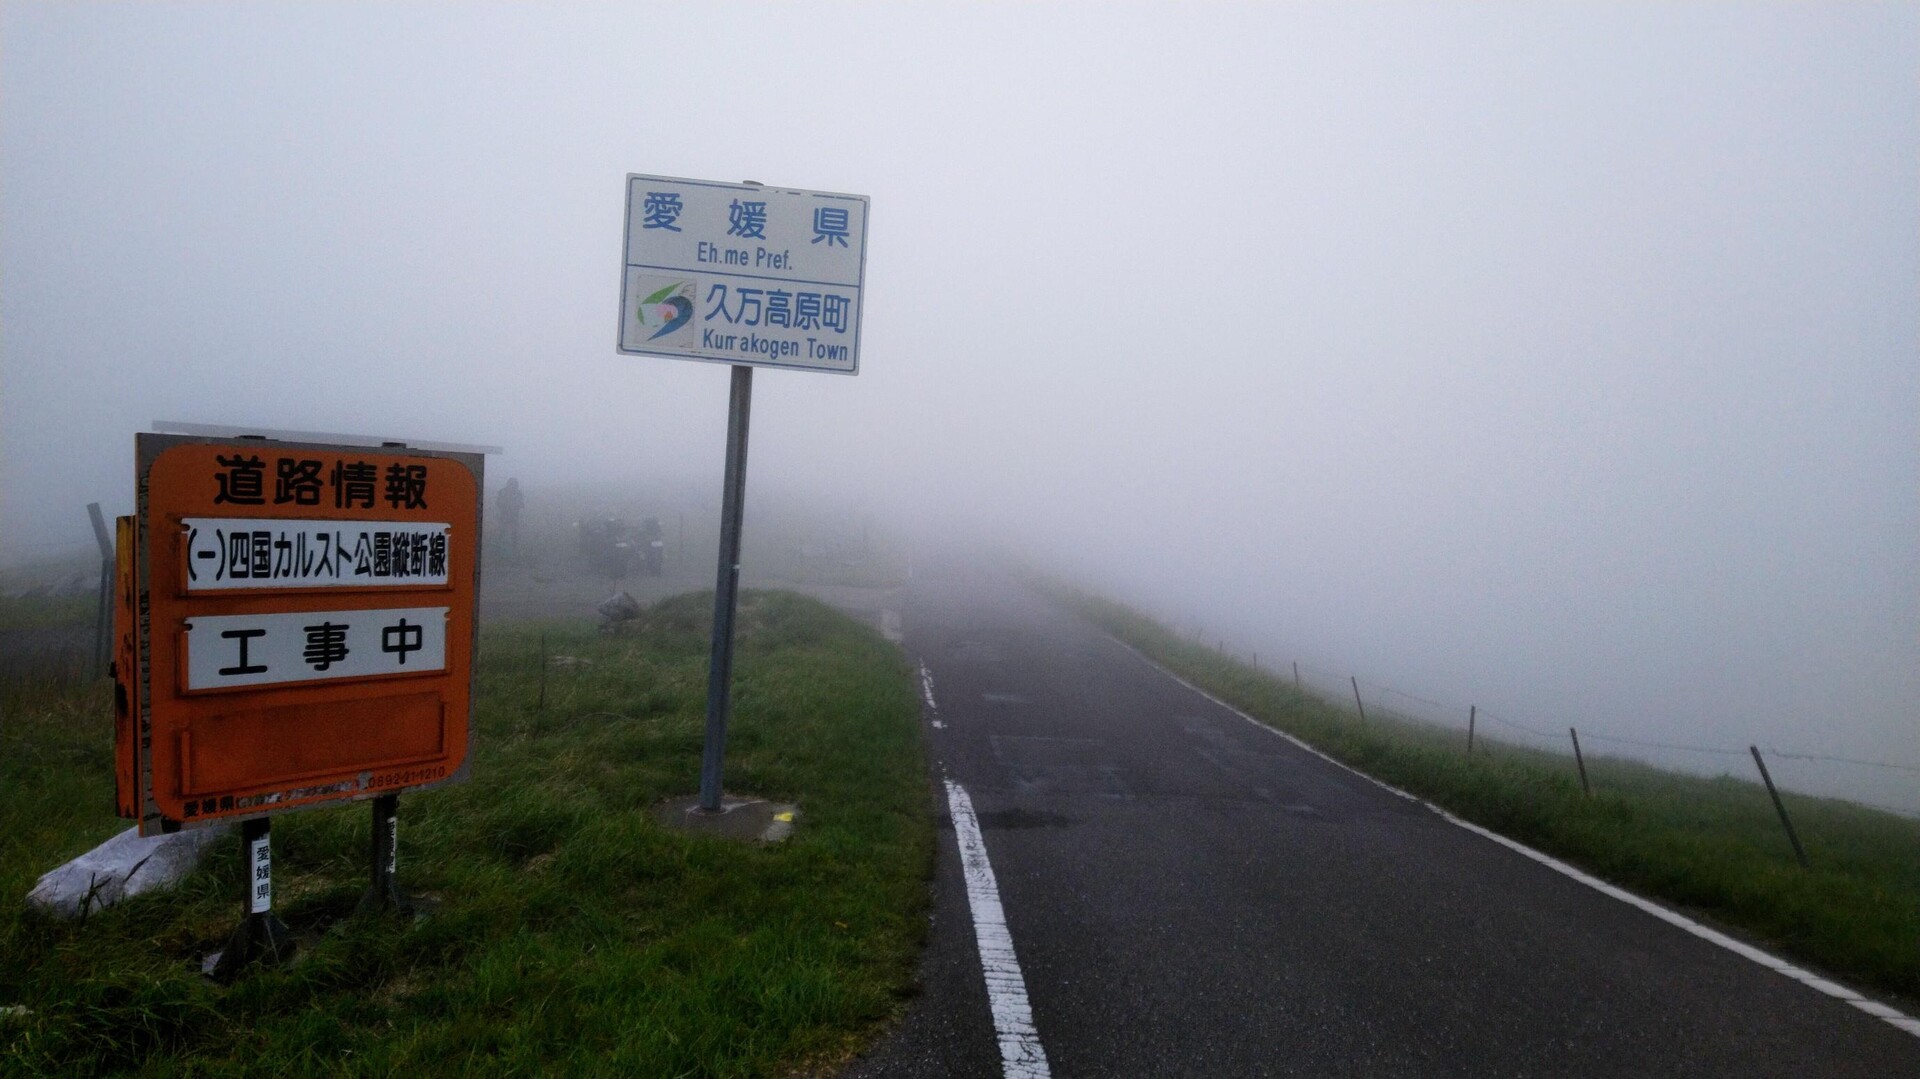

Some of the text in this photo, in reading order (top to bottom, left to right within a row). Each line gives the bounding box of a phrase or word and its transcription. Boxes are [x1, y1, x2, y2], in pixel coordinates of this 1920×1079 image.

[643, 192, 850, 248] 愛媛県
[697, 242, 793, 271] Ehme Pref.
[704, 284, 851, 334] 久万高原町
[807, 338, 848, 362] Town
[214, 454, 429, 510] 道路情報
[187, 527, 446, 581] (一)四国カルスト公園縦断線
[218, 618, 423, 676] 工事中
[256, 845, 270, 900] 愛媛県
